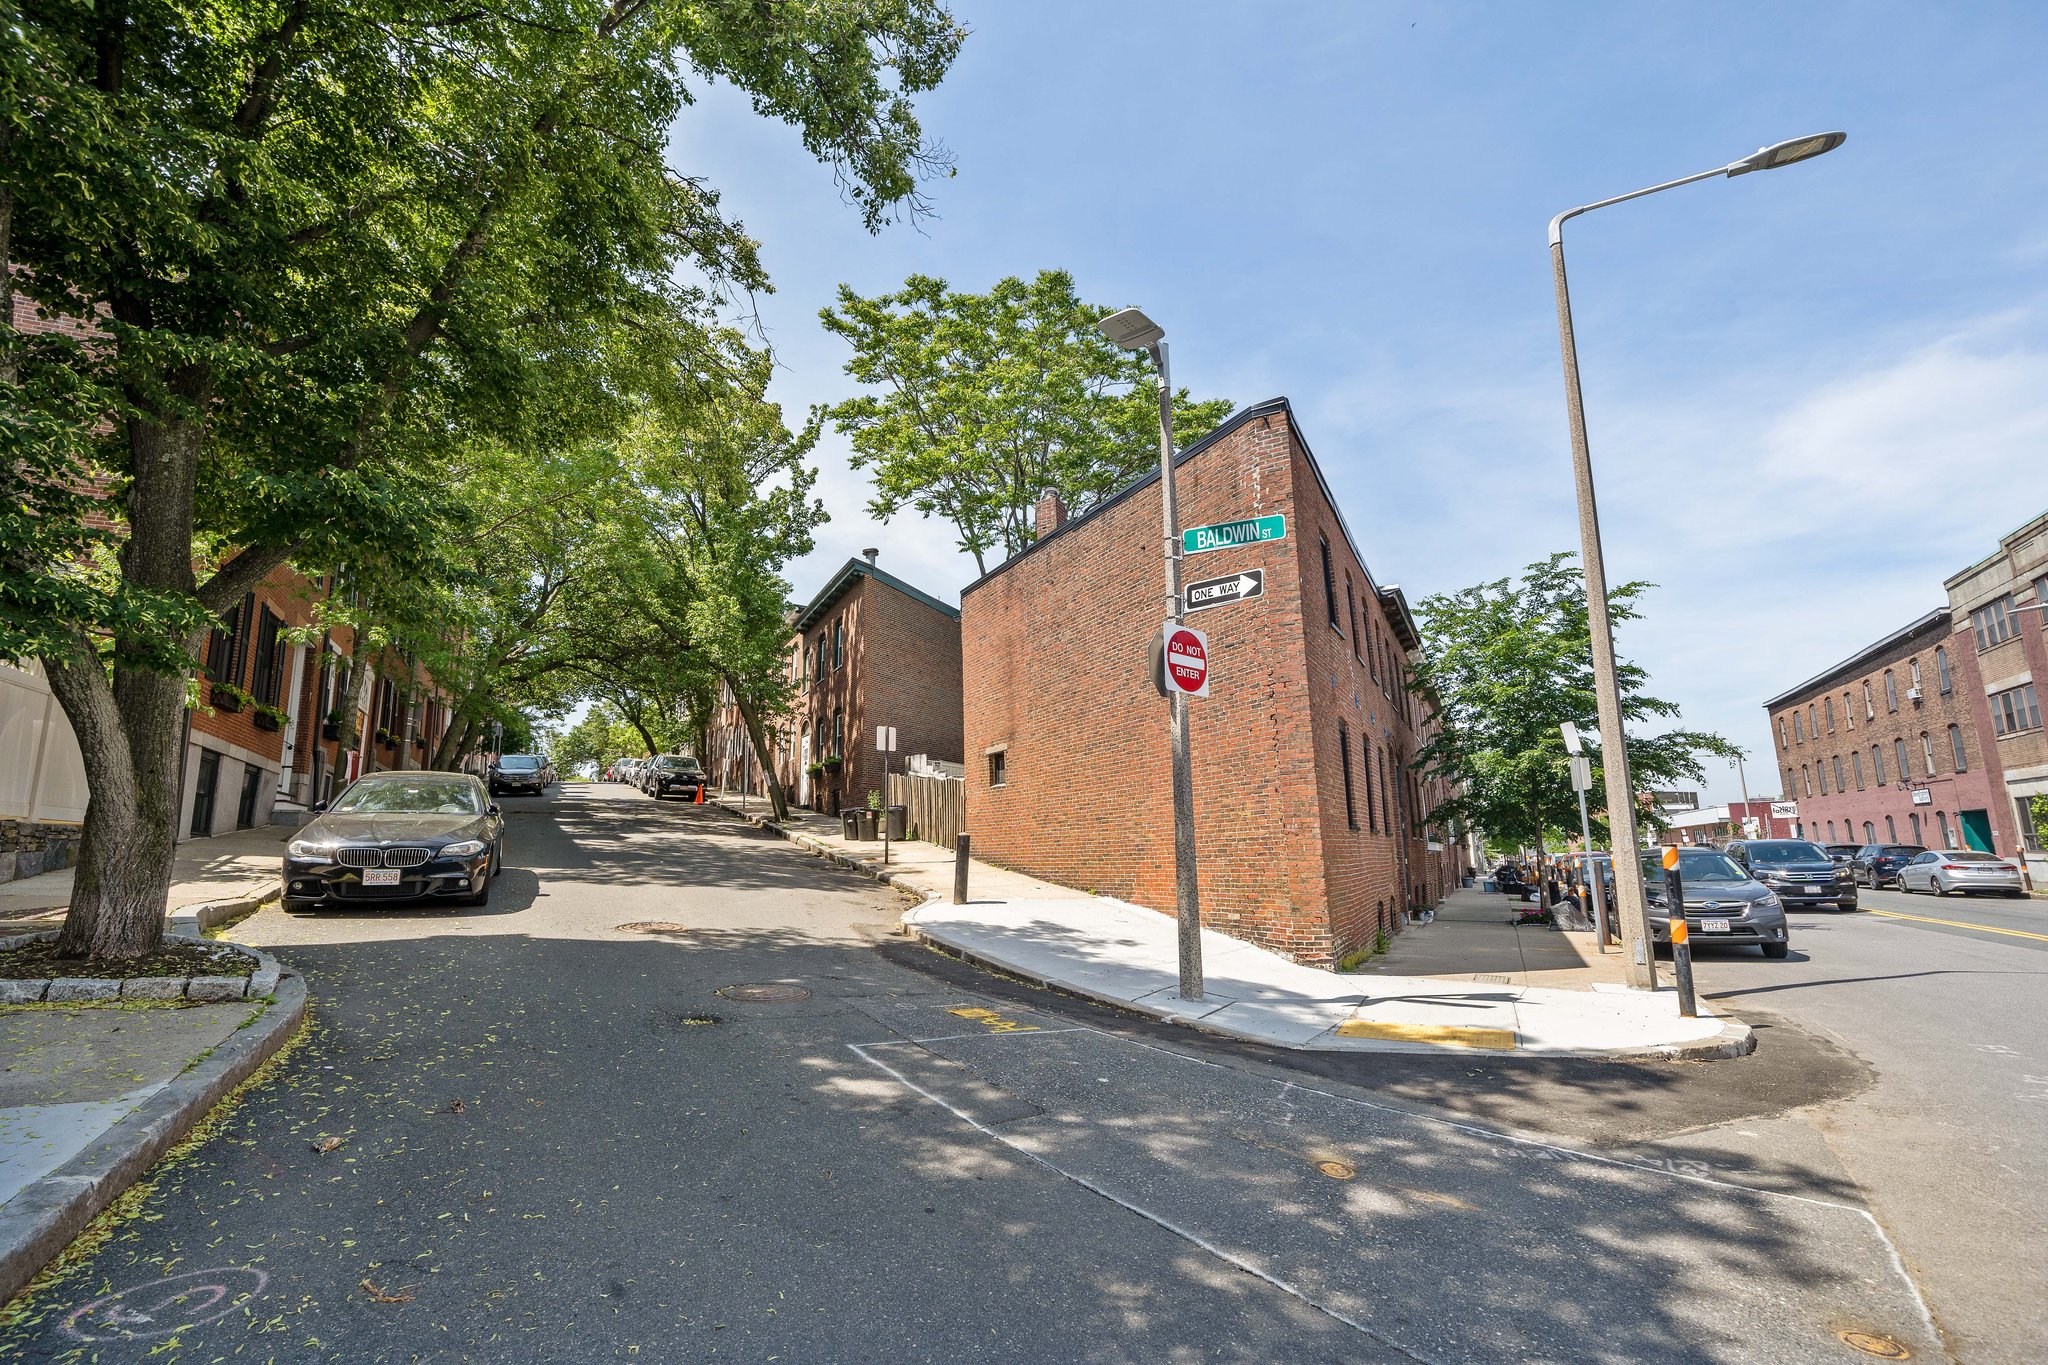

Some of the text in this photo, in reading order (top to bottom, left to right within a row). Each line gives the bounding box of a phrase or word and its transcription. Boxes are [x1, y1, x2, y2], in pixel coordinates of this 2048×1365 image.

[1197, 522, 1272, 548] BALDWIN ST
[1194, 582, 1240, 600] ONE WAY
[1172, 642, 1201, 656] DO NOT
[1176, 667, 1200, 680] ENTER
[365, 873, 381, 881] 5RR
